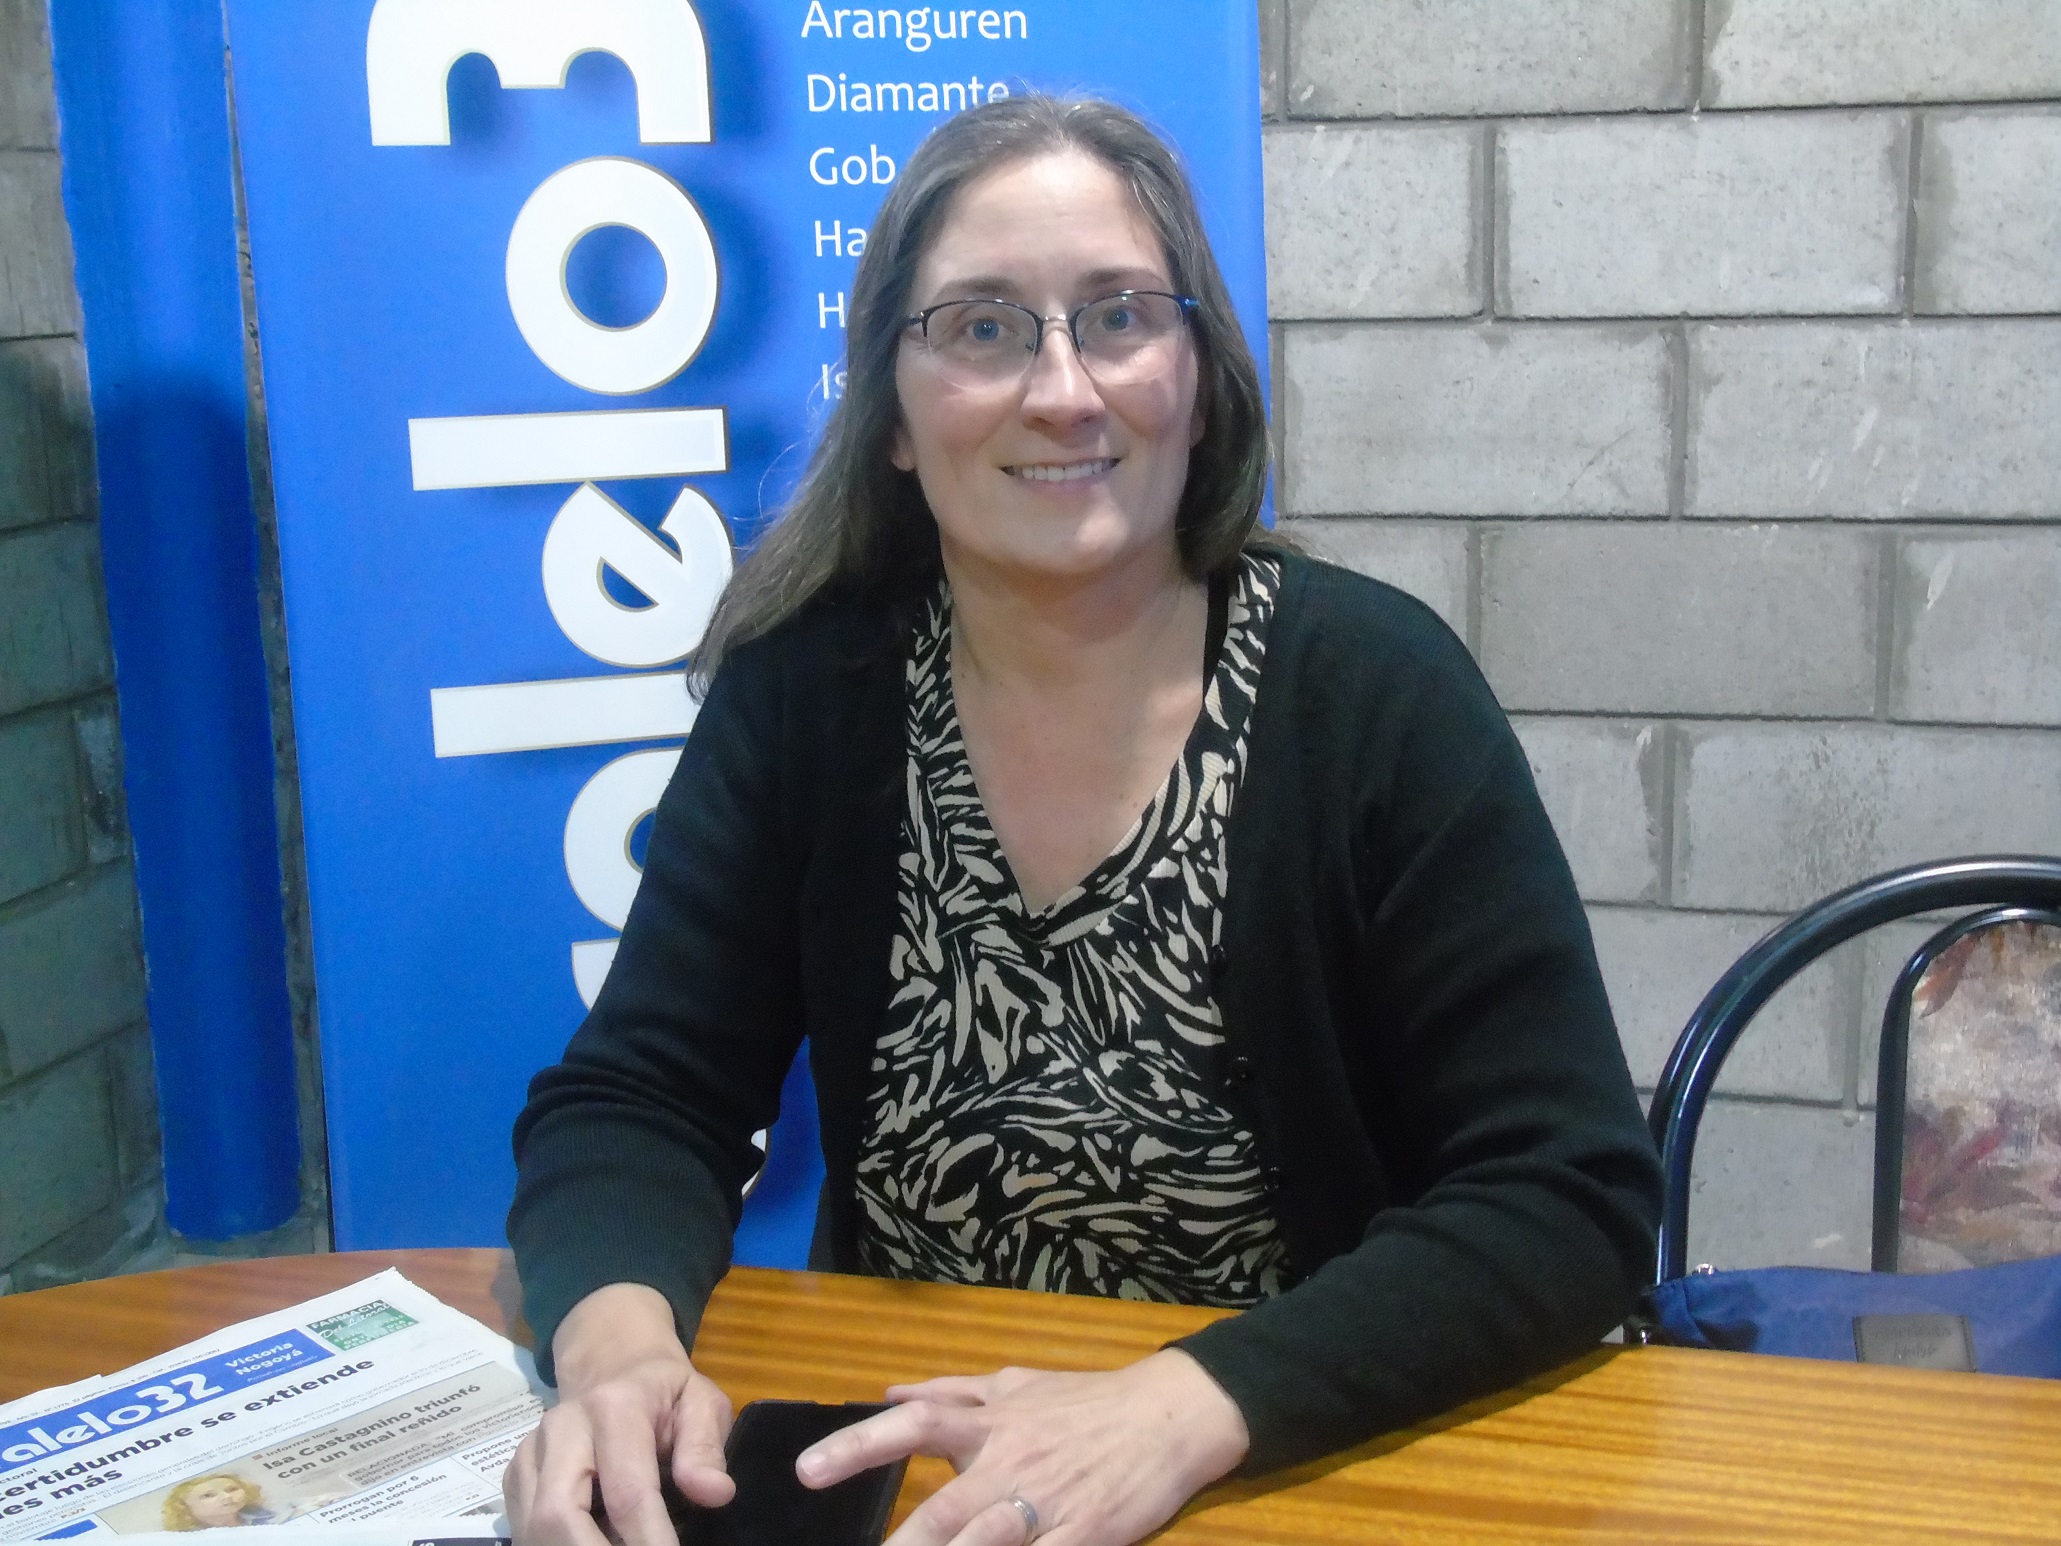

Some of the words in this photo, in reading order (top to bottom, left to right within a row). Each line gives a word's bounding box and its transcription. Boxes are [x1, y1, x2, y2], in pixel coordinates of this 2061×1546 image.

[801, 0, 1027, 52] Aranguren
[807, 73, 1010, 113] Diamante
[809, 144, 897, 186] Gob
[814, 220, 868, 257] Ha
[311, 1302, 382, 1328] FARMACIA
[225, 1343, 293, 1367] Victoria
[235, 1349, 303, 1375] Nogoyá
[0, 1373, 224, 1464] alelo32
[0, 1426, 194, 1502] ertidumbre
[200, 1412, 237, 1428] se
[244, 1361, 374, 1411] extiende
[262, 1456, 296, 1470] Isa
[299, 1412, 412, 1456] Castagnino
[414, 1384, 480, 1413] triunfó
[461, 1404, 524, 1431] compromiso
[266, 1438, 311, 1457] Informe
[312, 1427, 339, 1439] local
[278, 1462, 317, 1479] con
[320, 1450, 348, 1464] un
[349, 1430, 397, 1452] final
[399, 1406, 462, 1434] reñido
[384, 1468, 399, 1476] en
[401, 1446, 454, 1469] entrevista
[456, 1437, 476, 1447] con
[407, 1448, 431, 1460] para
[432, 1436, 463, 1448] todos
[462, 1438, 512, 1461] Propone
[514, 1431, 530, 1440] un
[471, 1445, 518, 1467] estética
[0, 1498, 43, 1519] es
[50, 1470, 122, 1499] más
[320, 1491, 384, 1518] Prorrogan
[386, 1480, 407, 1494] por
[328, 1505, 369, 1525] meses
[370, 1499, 383, 1507] la
[385, 1474, 447, 1501] concesión
[359, 1500, 404, 1521] puente
